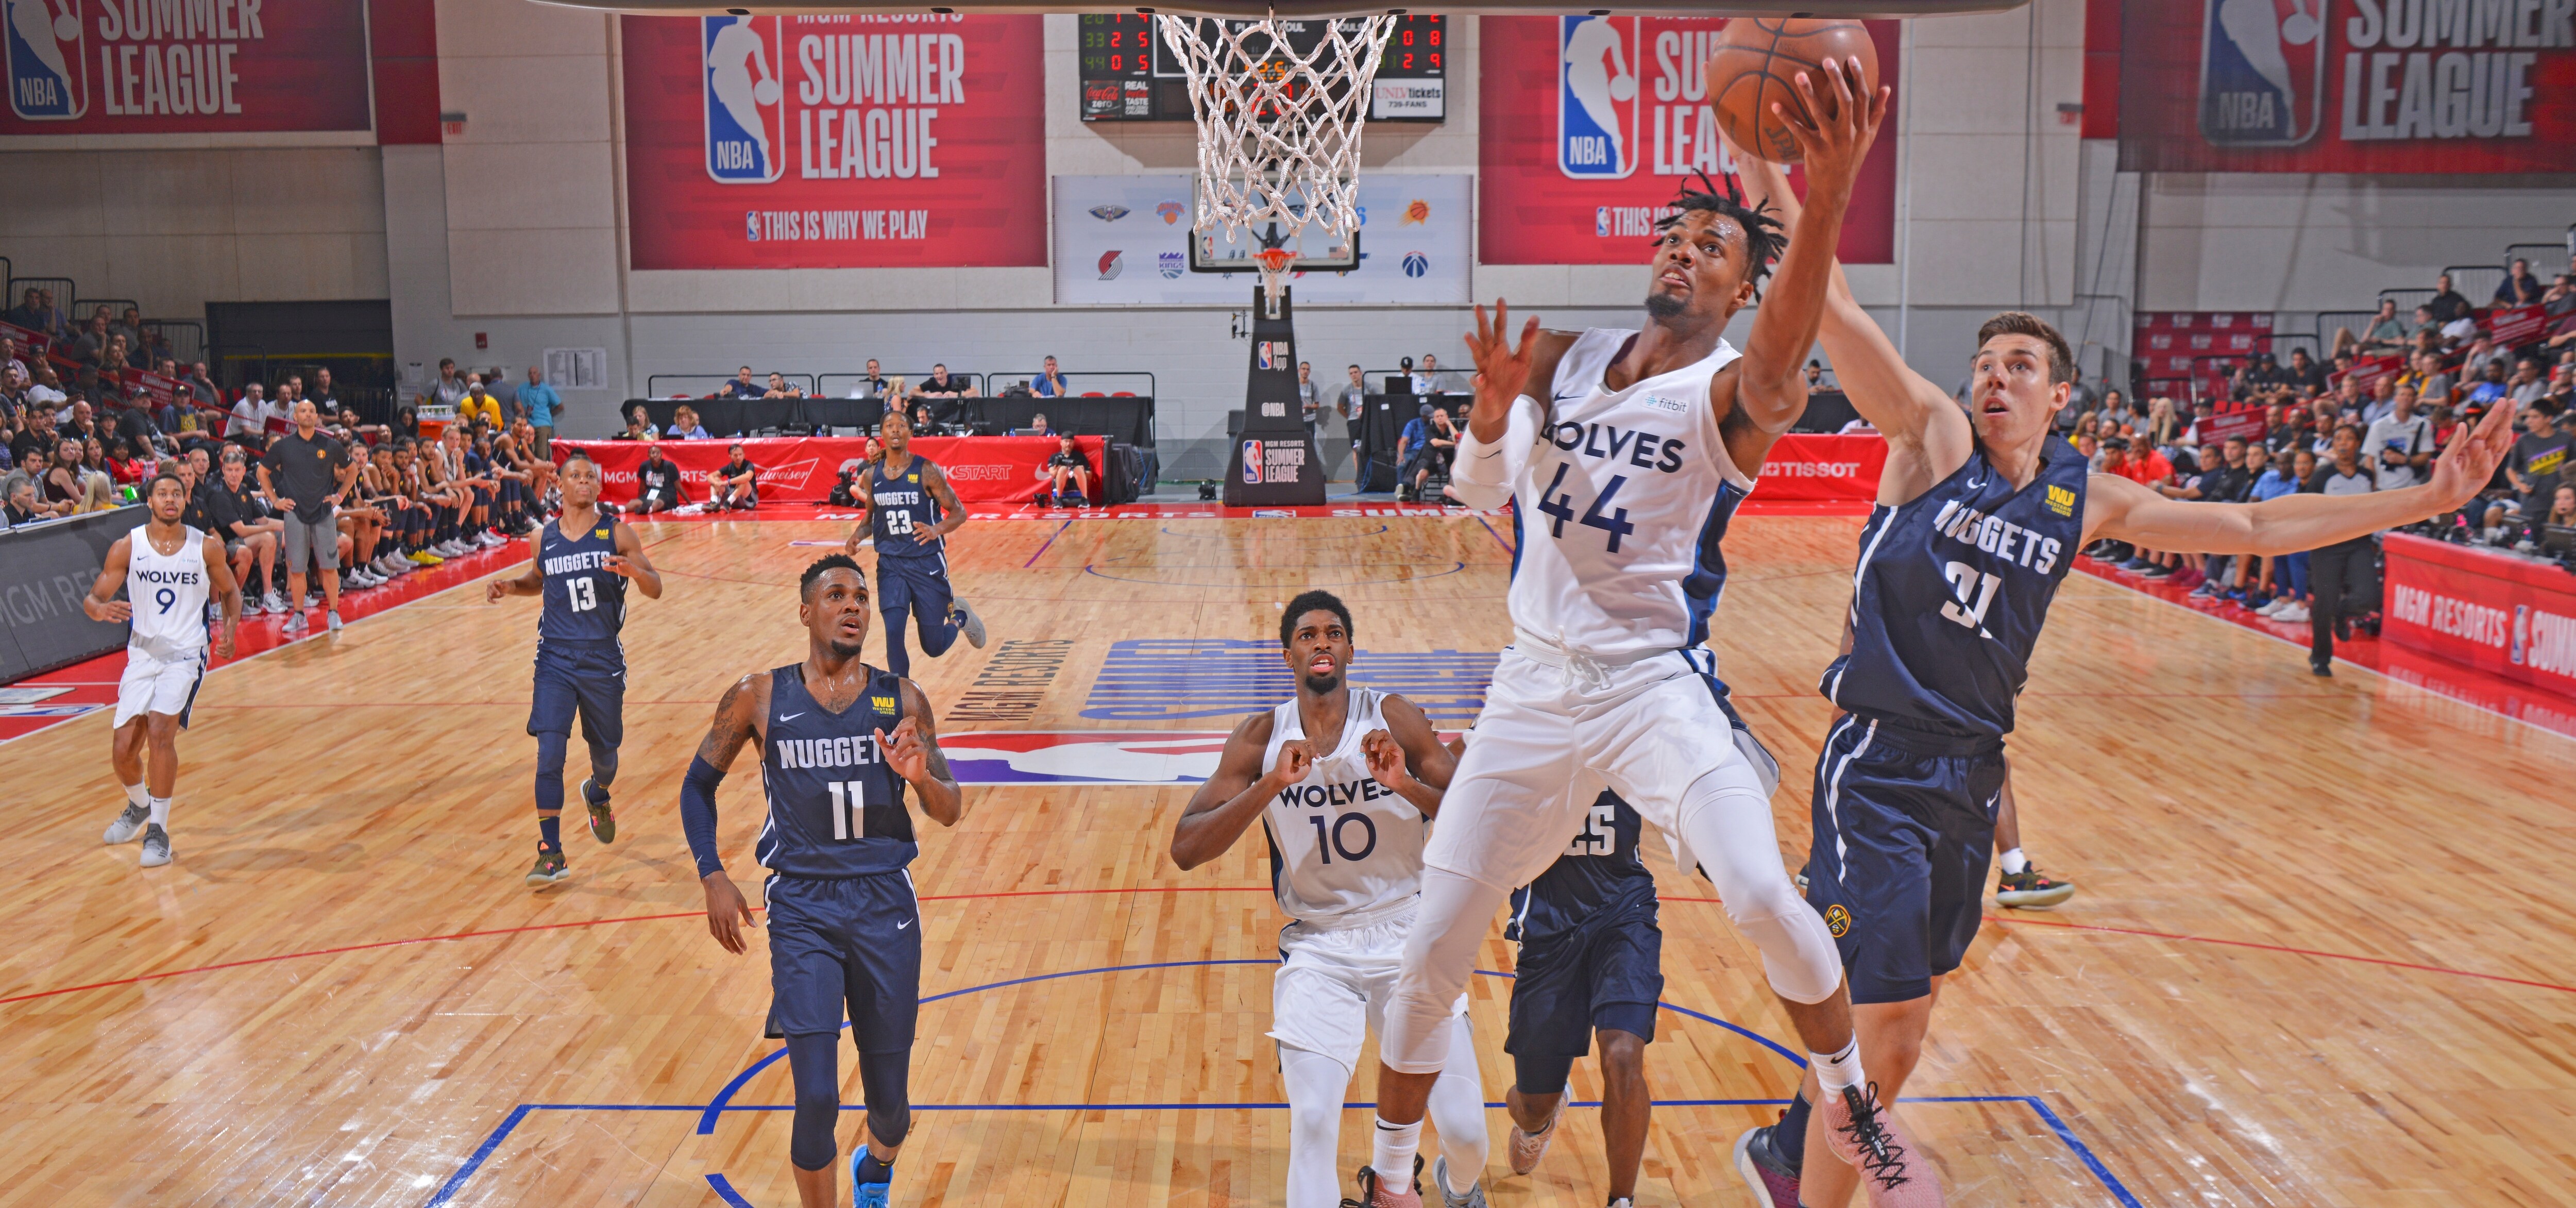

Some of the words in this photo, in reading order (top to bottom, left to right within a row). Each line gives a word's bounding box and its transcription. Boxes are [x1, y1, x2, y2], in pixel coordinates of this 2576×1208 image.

[98, 0, 264, 40] SUMMER
[1086, 32, 1105, 47] 33
[1111, 31, 1122, 47] 2
[1138, 31, 1149, 47] 5
[1403, 30, 1414, 46] 0
[1430, 30, 1440, 46] 8
[799, 34, 965, 105] SUMMER
[1085, 56, 1105, 70] 44
[1111, 55, 1122, 70] 0
[1139, 55, 1148, 70] 5
[1403, 53, 1414, 69] 2
[1430, 53, 1440, 68] 9
[20, 77, 58, 106] NBA
[100, 43, 242, 115] LEAGUE
[1125, 81, 1148, 90] REAL
[1125, 97, 1148, 106] TASTE
[2341, 52, 2537, 140] LEAGUE
[2218, 91, 2275, 129] NBA
[717, 141, 754, 170] NBA
[800, 108, 939, 179] LEAGUE
[1570, 136, 1607, 165] NBA
[762, 211, 800, 241] THIS
[804, 210, 820, 240] IS
[822, 210, 859, 240] WHY
[862, 210, 886, 240] WE
[889, 210, 928, 240] PLAY
[1613, 207, 1650, 237] THIS
[1273, 342, 1289, 355] NBA
[1273, 356, 1287, 371] App
[1261, 402, 1285, 416] @NBA
[1658, 397, 1688, 413] fitbit
[1265, 448, 1304, 465] SUMMER
[604, 471, 638, 483] MGM
[1265, 465, 1298, 483] LEAGUE
[1781, 462, 1861, 478] TISSOT
[873, 491, 919, 506] NUGGETS
[1537, 461, 1635, 554] 44
[2045, 498, 2072, 512] WESTERN
[2047, 484, 2076, 507] WU
[886, 510, 913, 535] 23
[968, 512, 1216, 520] RESORTS
[2052, 506, 2072, 517] UNION
[1933, 499, 2061, 575] NUGGETS
[544, 551, 611, 576] NUGGETS
[135, 570, 199, 584] WOLVES
[156, 588, 176, 614] 9
[566, 577, 597, 613] 13
[1940, 560, 2002, 639] 31
[2392, 583, 2430, 627] MGM
[2431, 594, 2507, 648] RESORTS
[972, 640, 1075, 686] RESORTS
[871, 696, 894, 708] WU
[944, 692, 1045, 721] MGM
[777, 734, 895, 769] NUGGET
[828, 781, 864, 840] 11
[1309, 812, 1377, 864] 10
